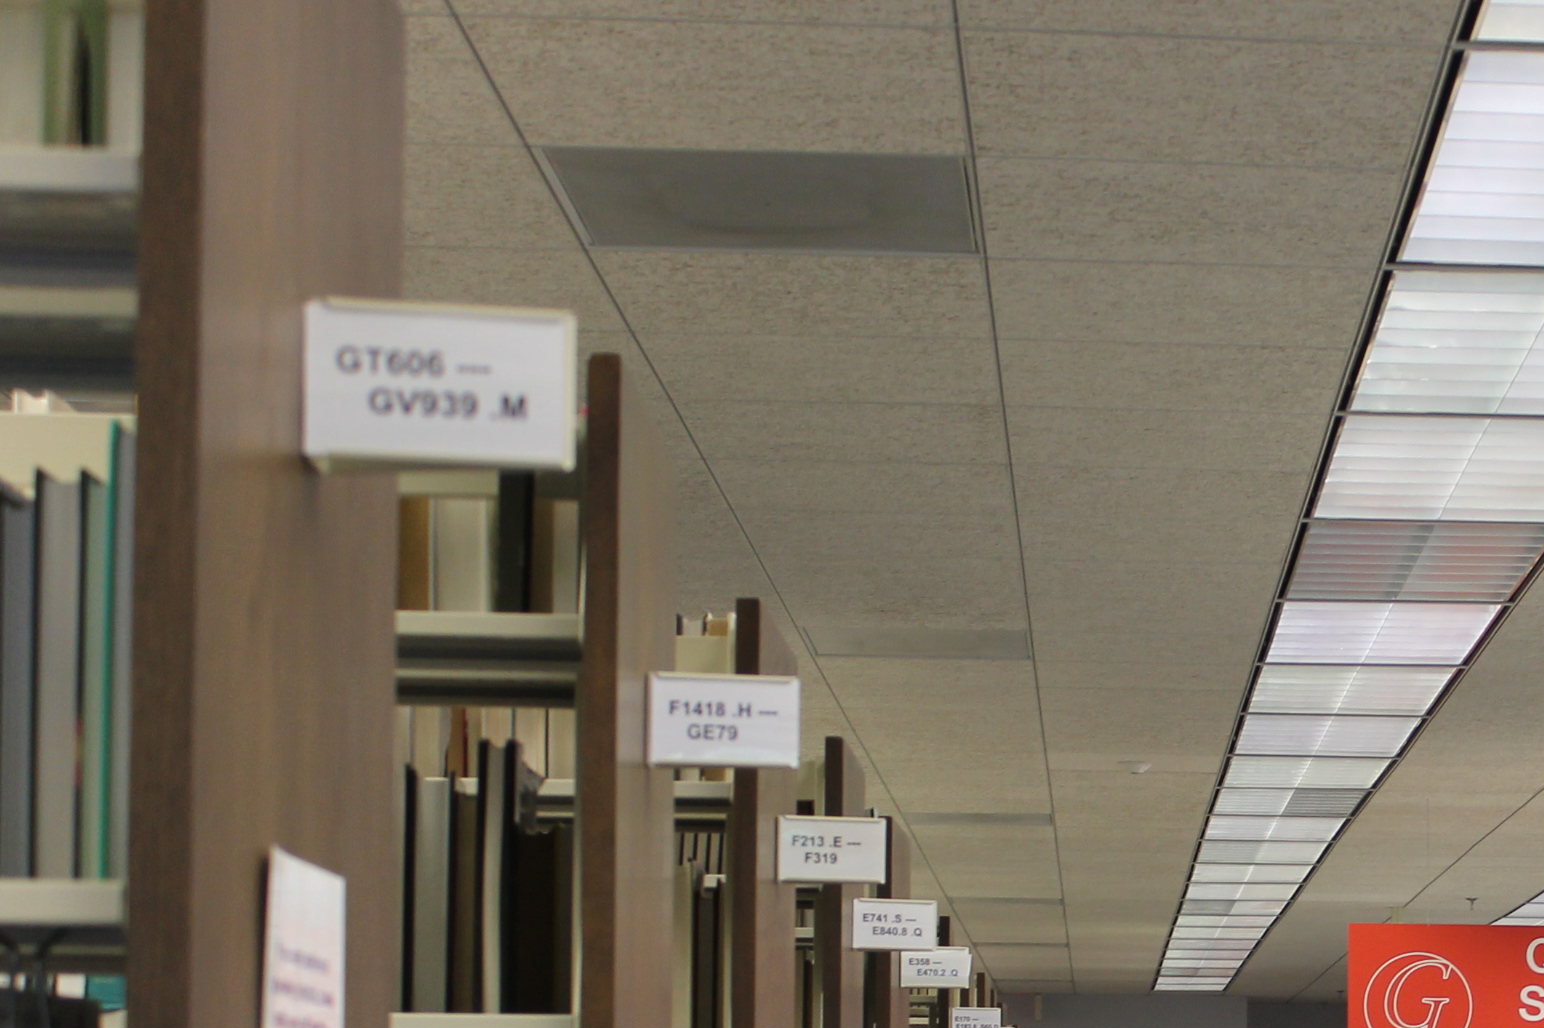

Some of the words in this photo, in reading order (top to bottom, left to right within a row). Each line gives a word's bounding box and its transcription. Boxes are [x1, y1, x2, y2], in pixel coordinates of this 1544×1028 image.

[335, 345, 445, 379] GT606
[368, 386, 479, 418] GV939
[668, 699, 725, 717] F1418
[686, 723, 738, 741] GE79
[791, 835, 825, 847] F213
[804, 852, 838, 864] F319
[862, 913, 888, 923] E741
[872, 926, 908, 936] E840.8
[908, 958, 930, 966] E358
